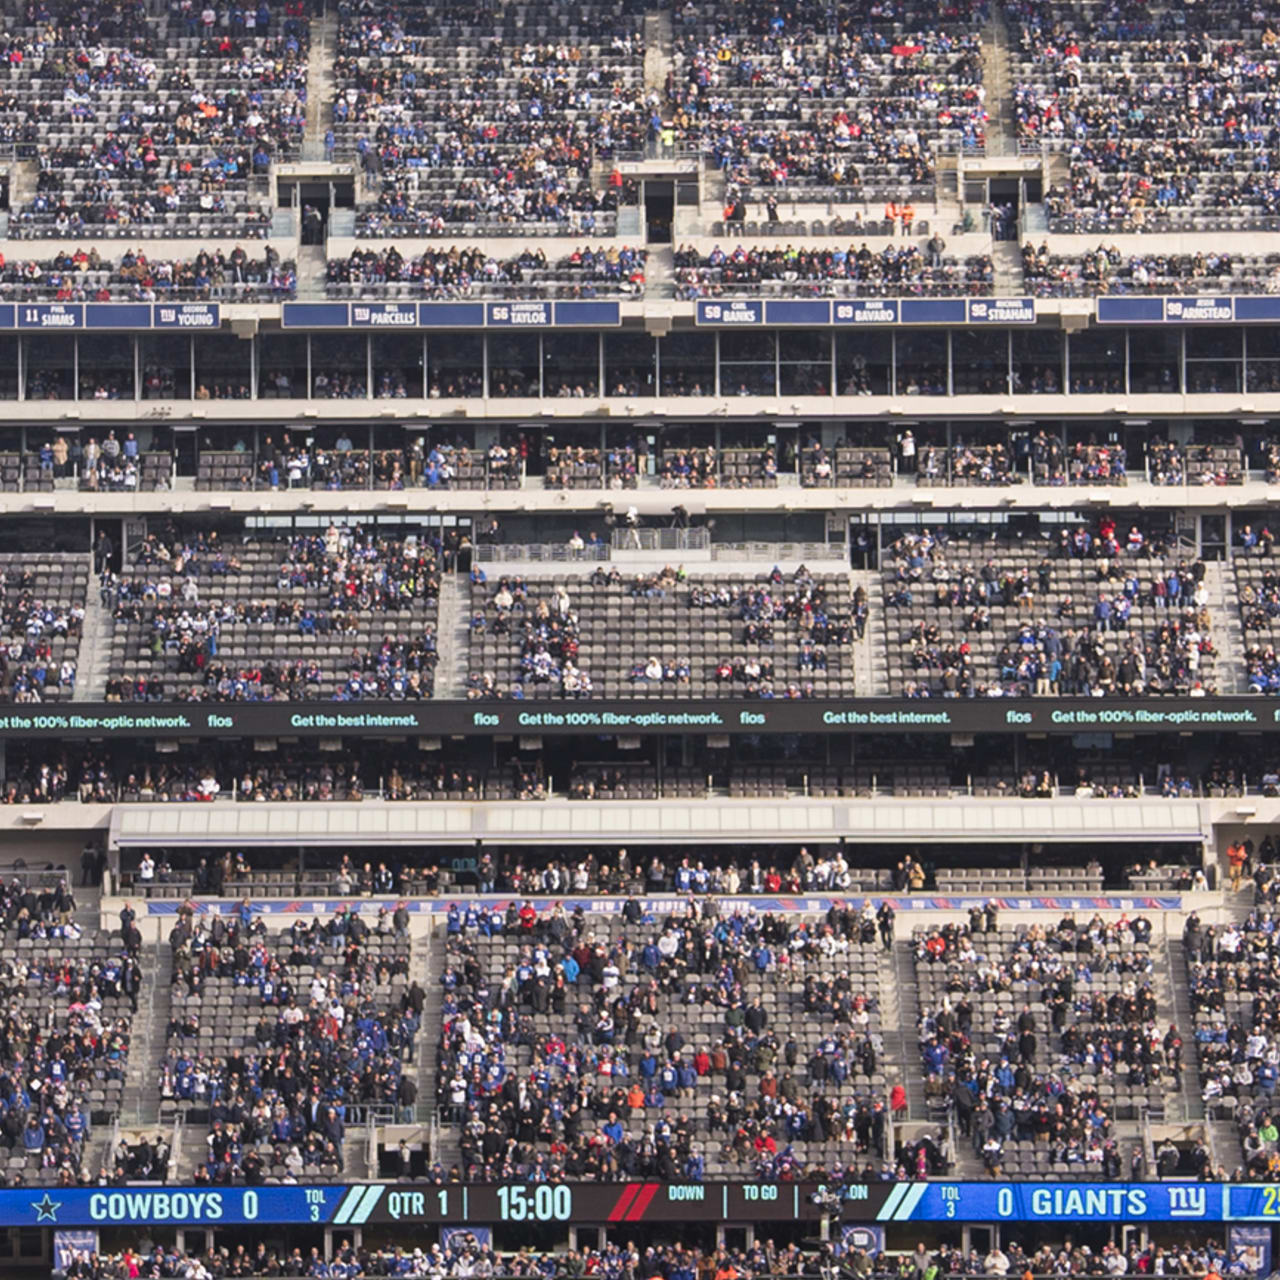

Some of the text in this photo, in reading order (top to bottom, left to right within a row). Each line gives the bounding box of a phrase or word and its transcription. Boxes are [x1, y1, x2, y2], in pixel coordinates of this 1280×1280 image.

[26, 310, 75, 326] 11 SIMMS
[178, 313, 214, 325] YOUNG
[370, 312, 415, 324] PARCELLS
[511, 312, 547, 323] TAYLOR
[723, 310, 756, 322] BANKS
[854, 310, 894, 321] BAVARO
[988, 308, 1032, 320] STRAHAN
[1182, 307, 1230, 319] ARMSTEAD
[9, 715, 31, 729] the
[32, 715, 69, 729] 100%
[68, 715, 134, 730] fiber-optic
[135, 714, 191, 728] network.
[305, 1189, 326, 1204] TOL
[669, 1185, 704, 1200] DOWN
[743, 1185, 777, 1200] TO GO
[850, 1185, 868, 1199] ON
[941, 1186, 960, 1201] TOL
[89, 1191, 259, 1220] COWBOYS 0
[388, 1190, 448, 1218] QTR 1
[497, 1185, 571, 1220] 15:00
[998, 1188, 1147, 1217] 0 GIANTS
[1168, 1187, 1206, 1217] ny
[310, 1205, 320, 1221] 3
[946, 1202, 956, 1218] 3
